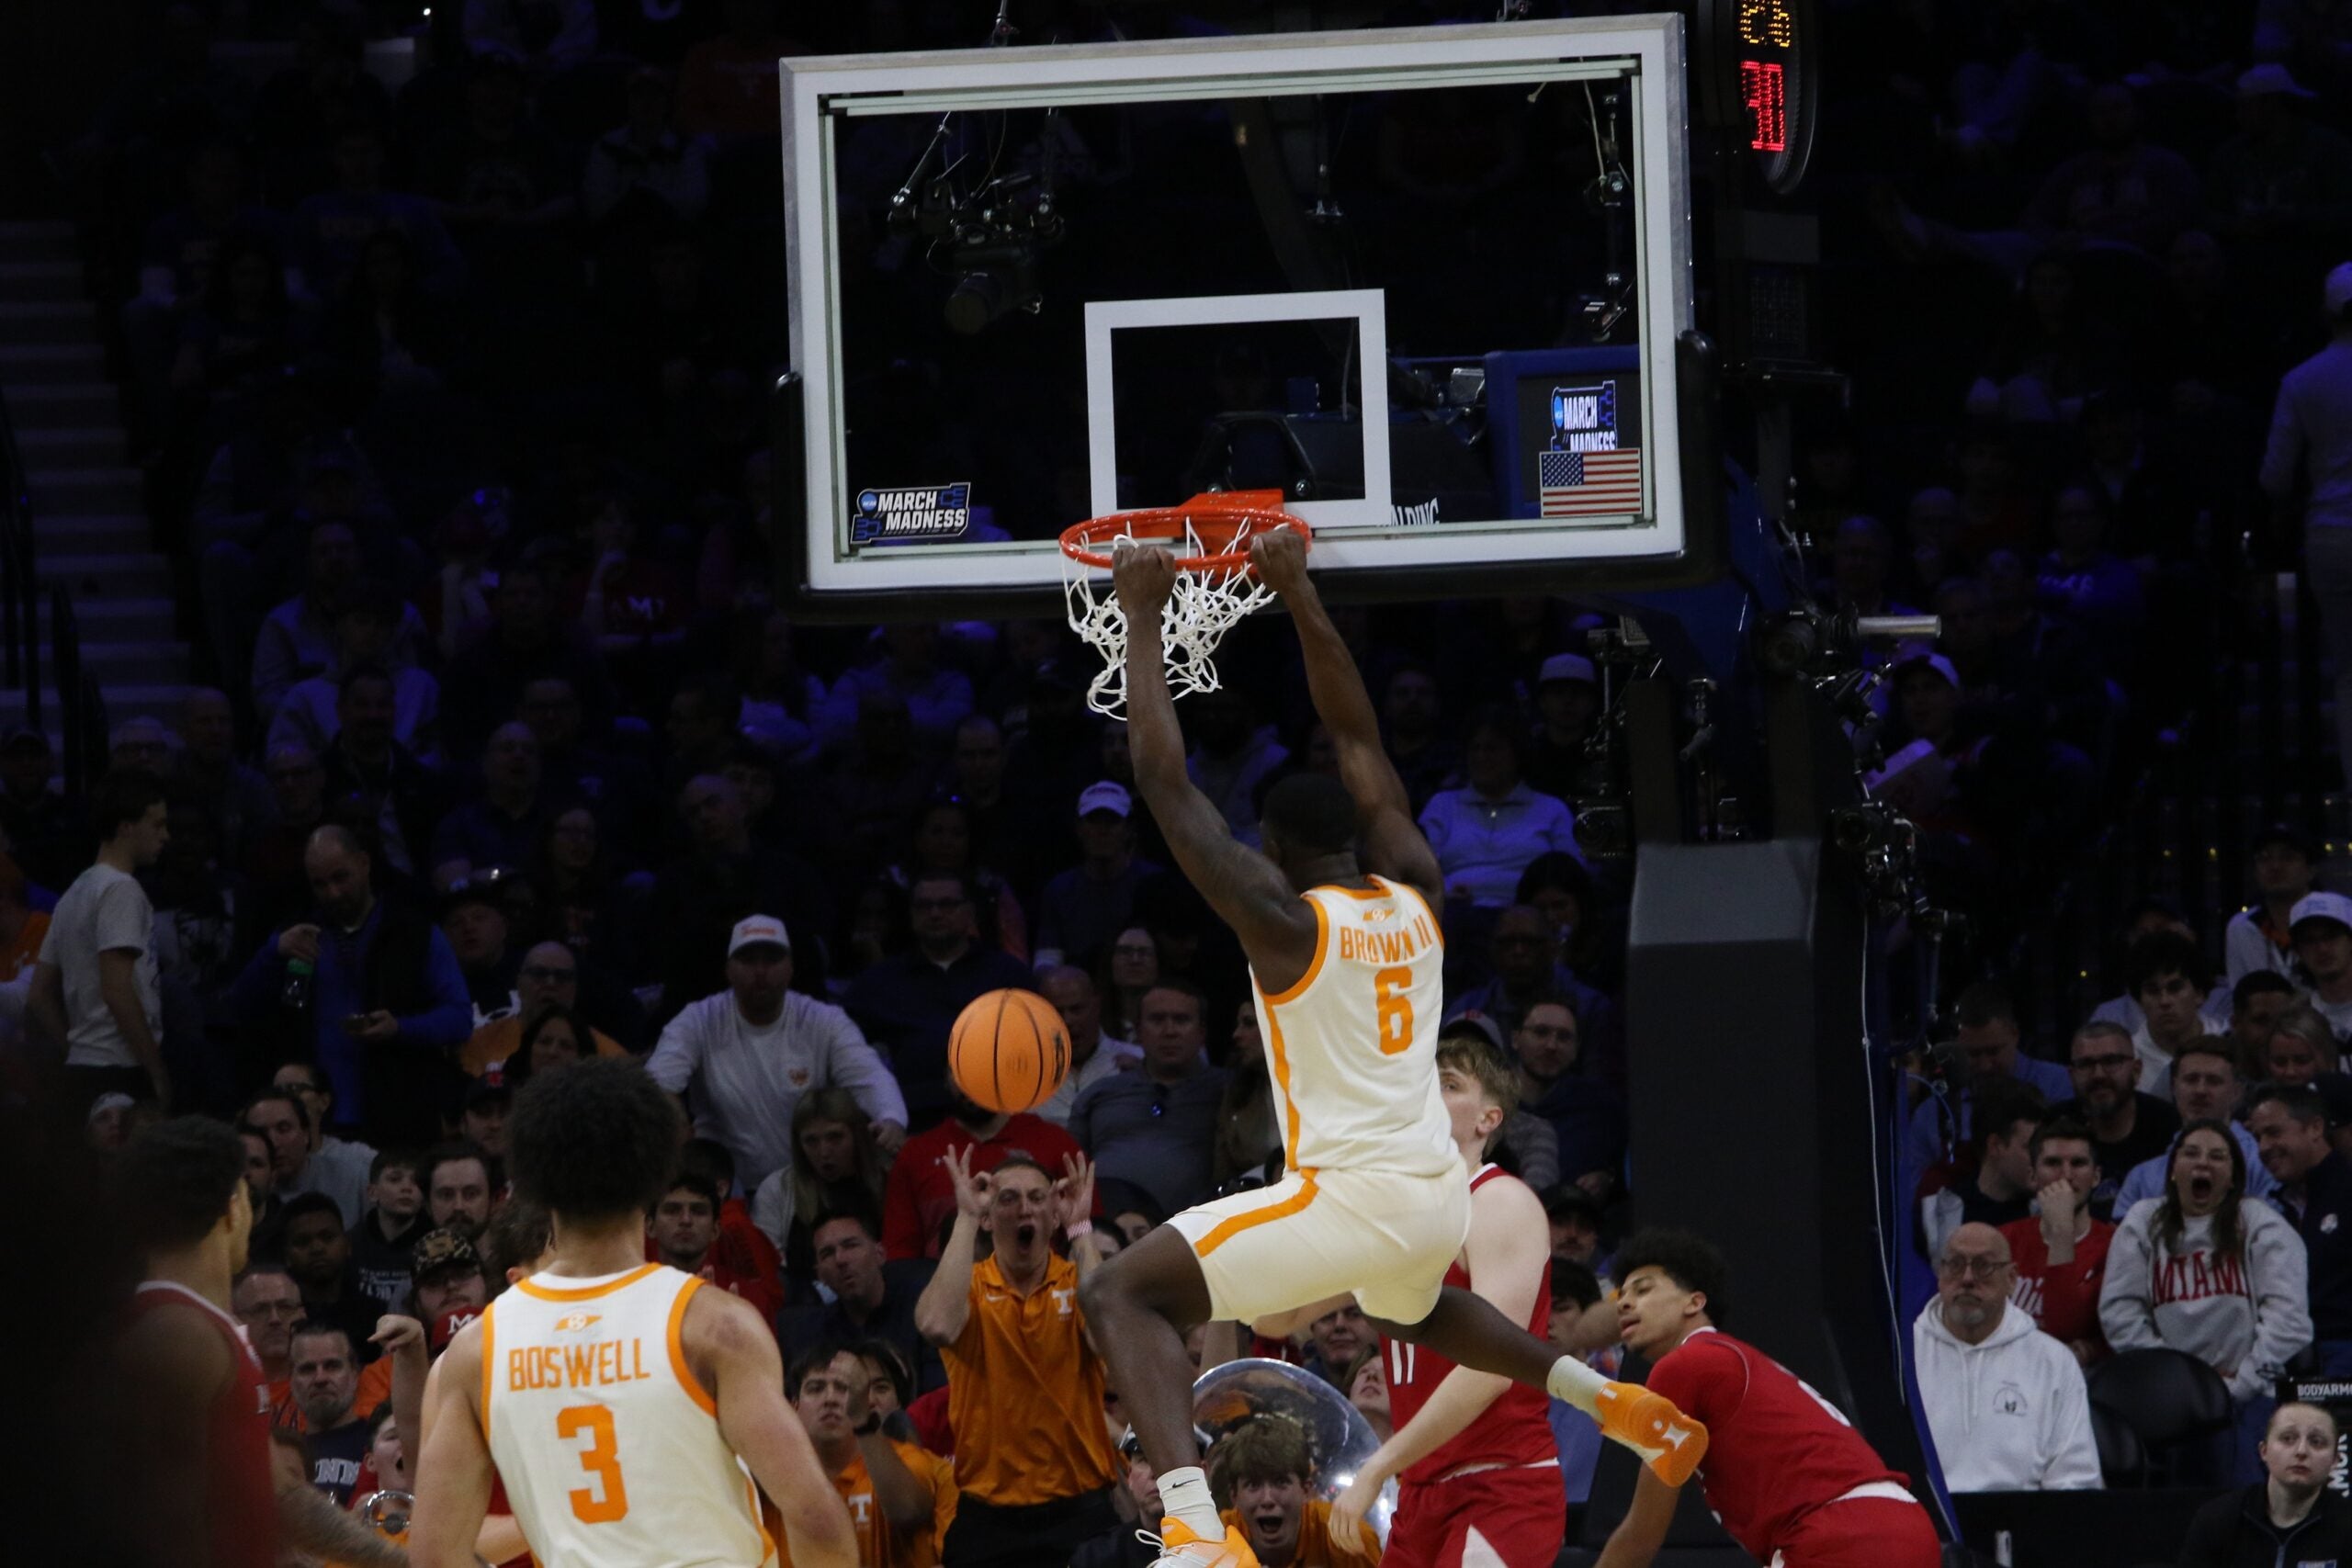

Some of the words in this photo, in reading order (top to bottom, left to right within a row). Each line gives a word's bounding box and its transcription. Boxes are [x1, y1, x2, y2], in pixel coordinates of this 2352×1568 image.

[1564, 395, 1598, 431] MARCH
[877, 491, 937, 512] MARCH
[885, 508, 967, 531] MADNESS
[1340, 925, 1415, 964] BROWN
[1413, 914, 1432, 949] II
[1374, 966, 1414, 1055] 6
[1051, 1287, 1074, 1314] T
[509, 1338, 650, 1392] BOSWELL
[557, 1404, 628, 1524] 3
[848, 1494, 872, 1524] T
